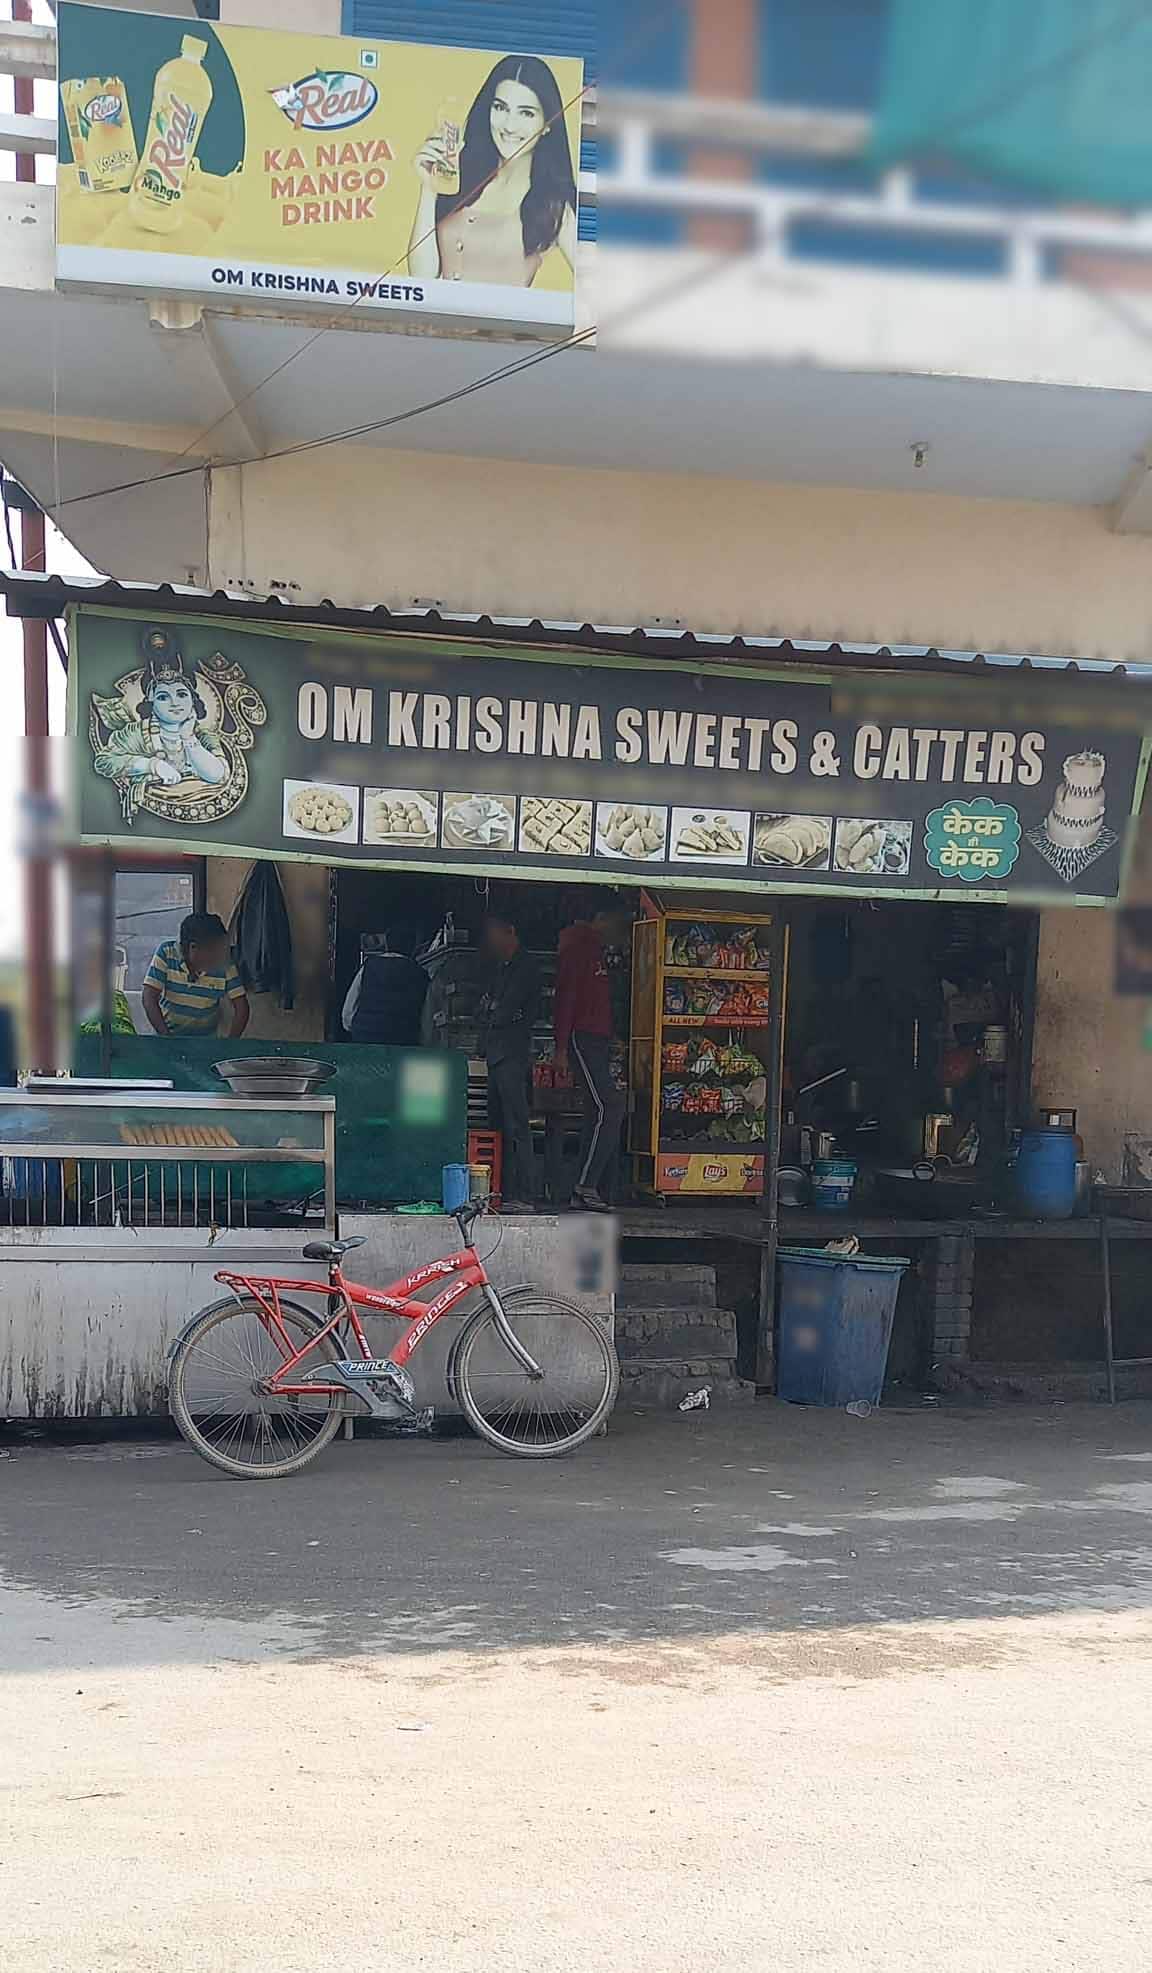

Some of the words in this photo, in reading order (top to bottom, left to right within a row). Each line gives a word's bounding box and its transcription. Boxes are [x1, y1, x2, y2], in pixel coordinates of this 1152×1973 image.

[91, 94, 121, 121] Real
[293, 78, 371, 130] Real
[149, 94, 192, 189] Real
[264, 148, 305, 172] KA
[316, 140, 392, 167] NAYA
[141, 176, 181, 200] Mango
[271, 168, 385, 199] MANGO
[282, 197, 374, 226] DRINK
[211, 268, 243, 285] OM
[251, 271, 339, 294] KRISHNA
[346, 281, 424, 302] SWEETS
[297, 681, 374, 744] OM
[389, 689, 602, 760] KRISHNA
[614, 707, 799, 775] SWEETS
[809, 730, 841, 778] &
[852, 724, 1047, 785] CATTERS
[943, 807, 1007, 835] केक
[940, 839, 1003, 867] केक
[349, 1360, 388, 1372] PRINCE
